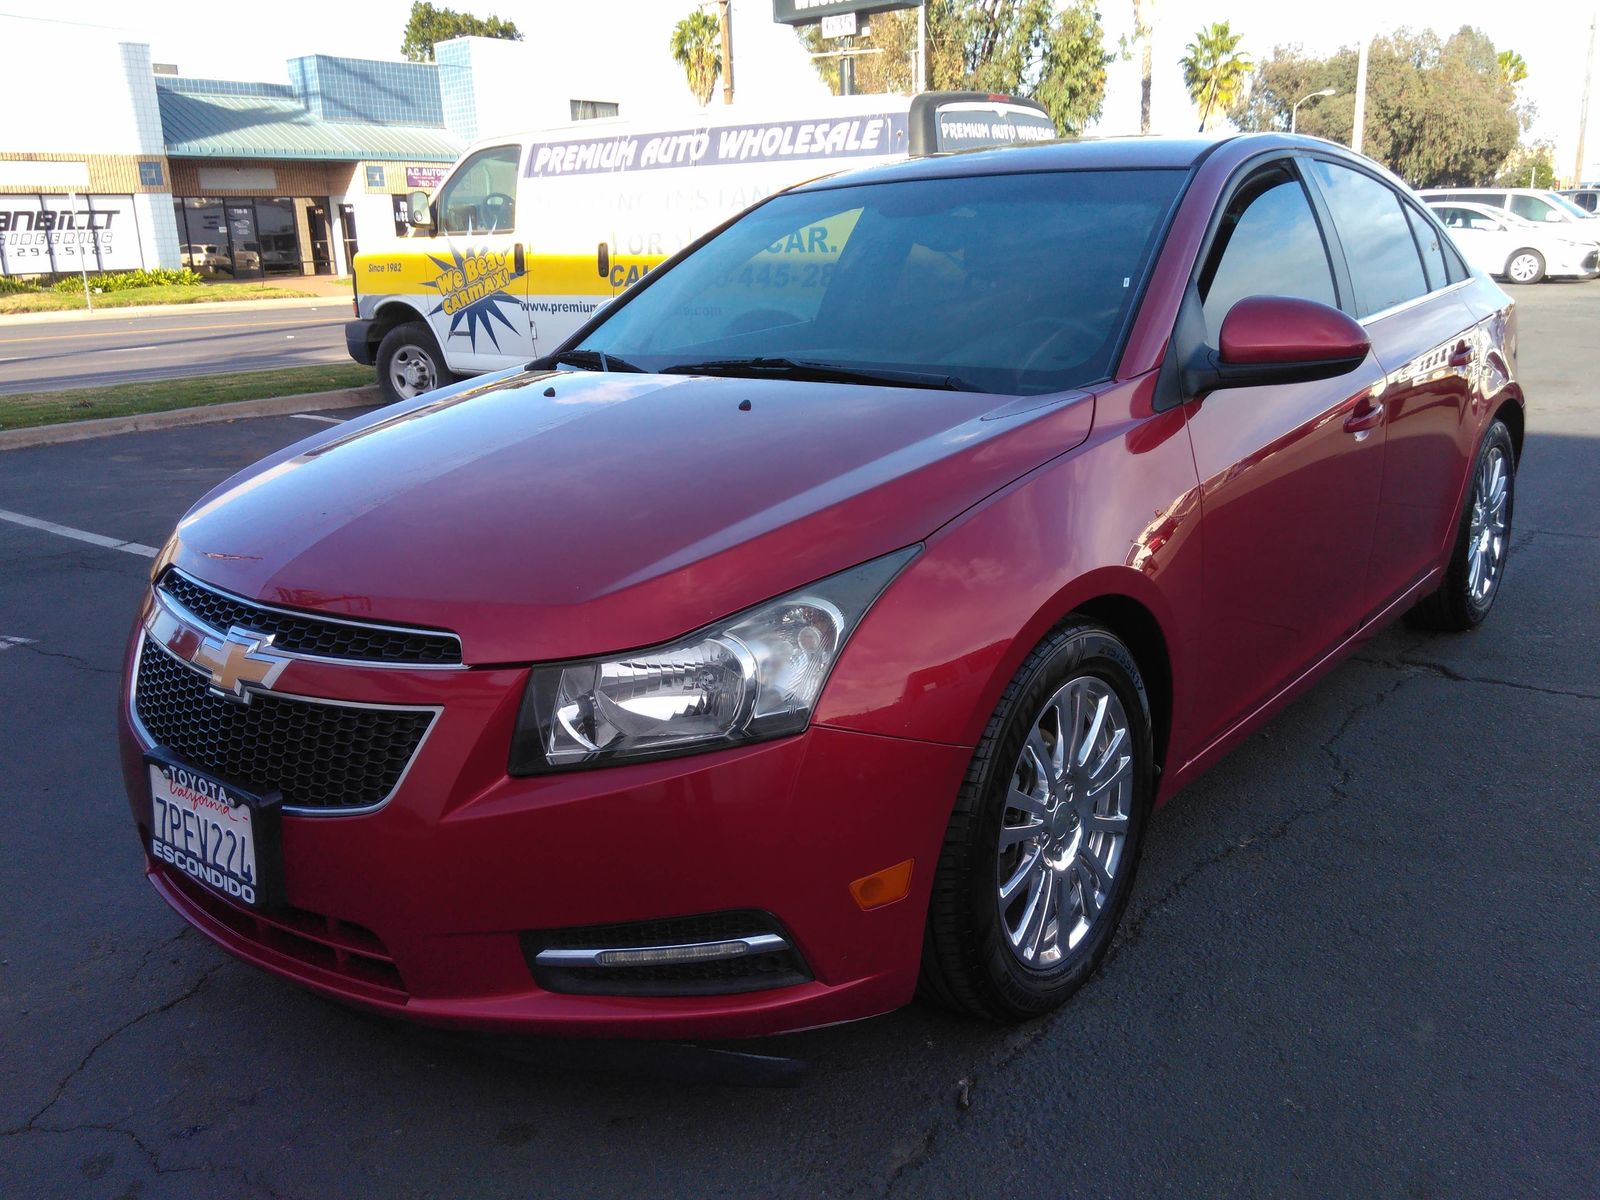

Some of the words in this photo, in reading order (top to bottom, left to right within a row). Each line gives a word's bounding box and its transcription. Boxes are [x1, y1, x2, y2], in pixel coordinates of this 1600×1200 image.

[534, 140, 638, 174] PREMIUM
[641, 133, 710, 167] AUTO
[718, 119, 884, 160] WHOLESALE
[941, 123, 990, 139] PREMIUM
[991, 124, 1016, 140] AUTO
[368, 263, 385, 273] Since
[386, 263, 402, 272] 1982
[436, 268, 464, 296] We
[463, 252, 506, 284] Beat
[442, 268, 511, 315] CARMAX!
[168, 779, 239, 822] California
[169, 765, 229, 805] TOYOTA
[153, 839, 256, 905] ESCONDIDO
